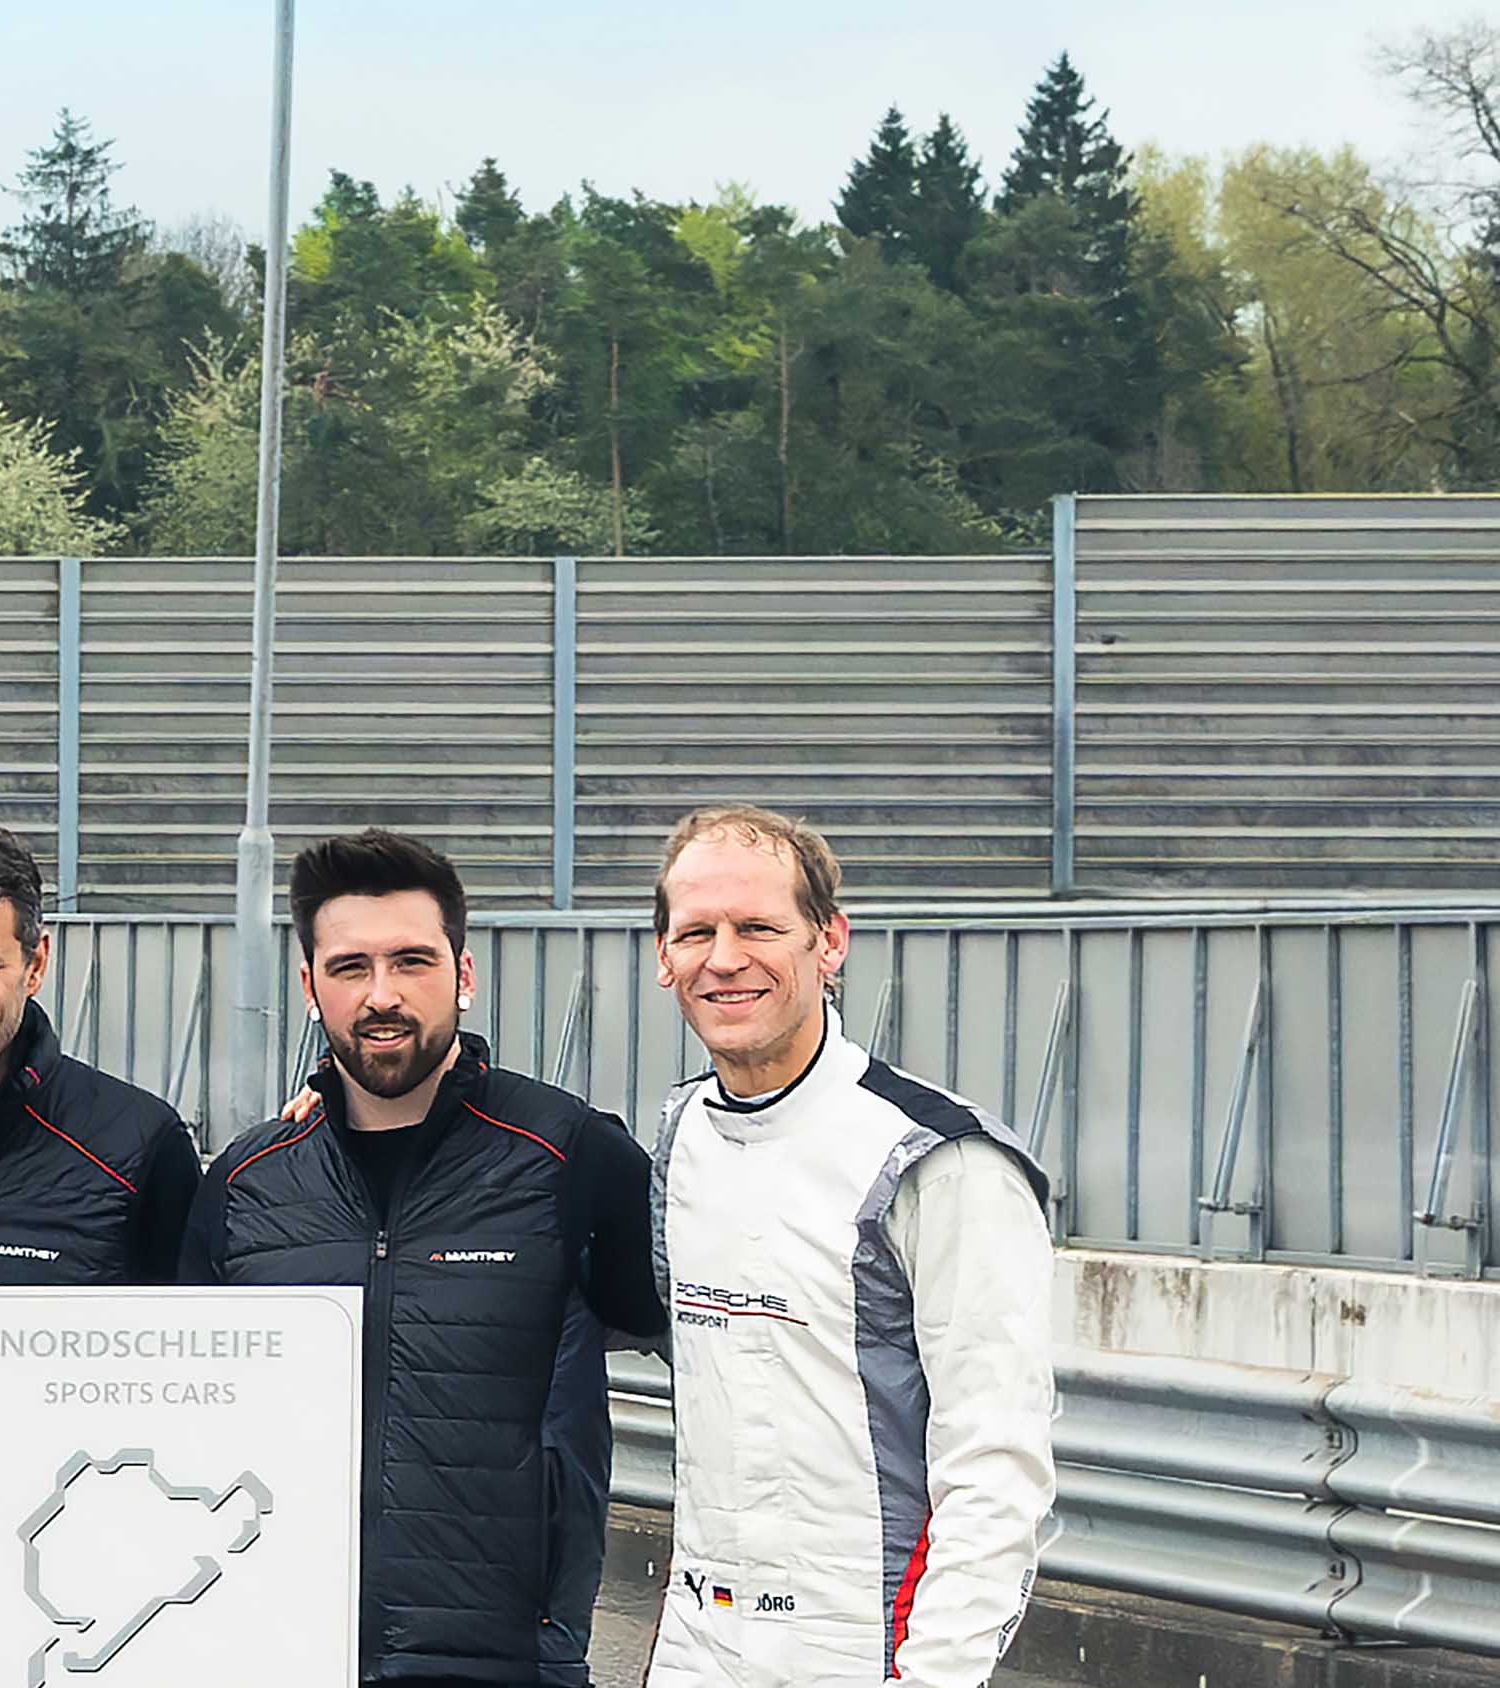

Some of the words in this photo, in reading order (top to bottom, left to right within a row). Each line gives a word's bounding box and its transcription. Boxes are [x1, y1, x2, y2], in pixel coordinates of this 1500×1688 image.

[445, 1251, 516, 1263] MANTHEY
[676, 1282, 788, 1313] PORSCHE
[0, 1328, 285, 1360] NORDSCHLEIFE
[43, 1380, 154, 1407] SPORTS
[161, 1381, 238, 1407] CARS
